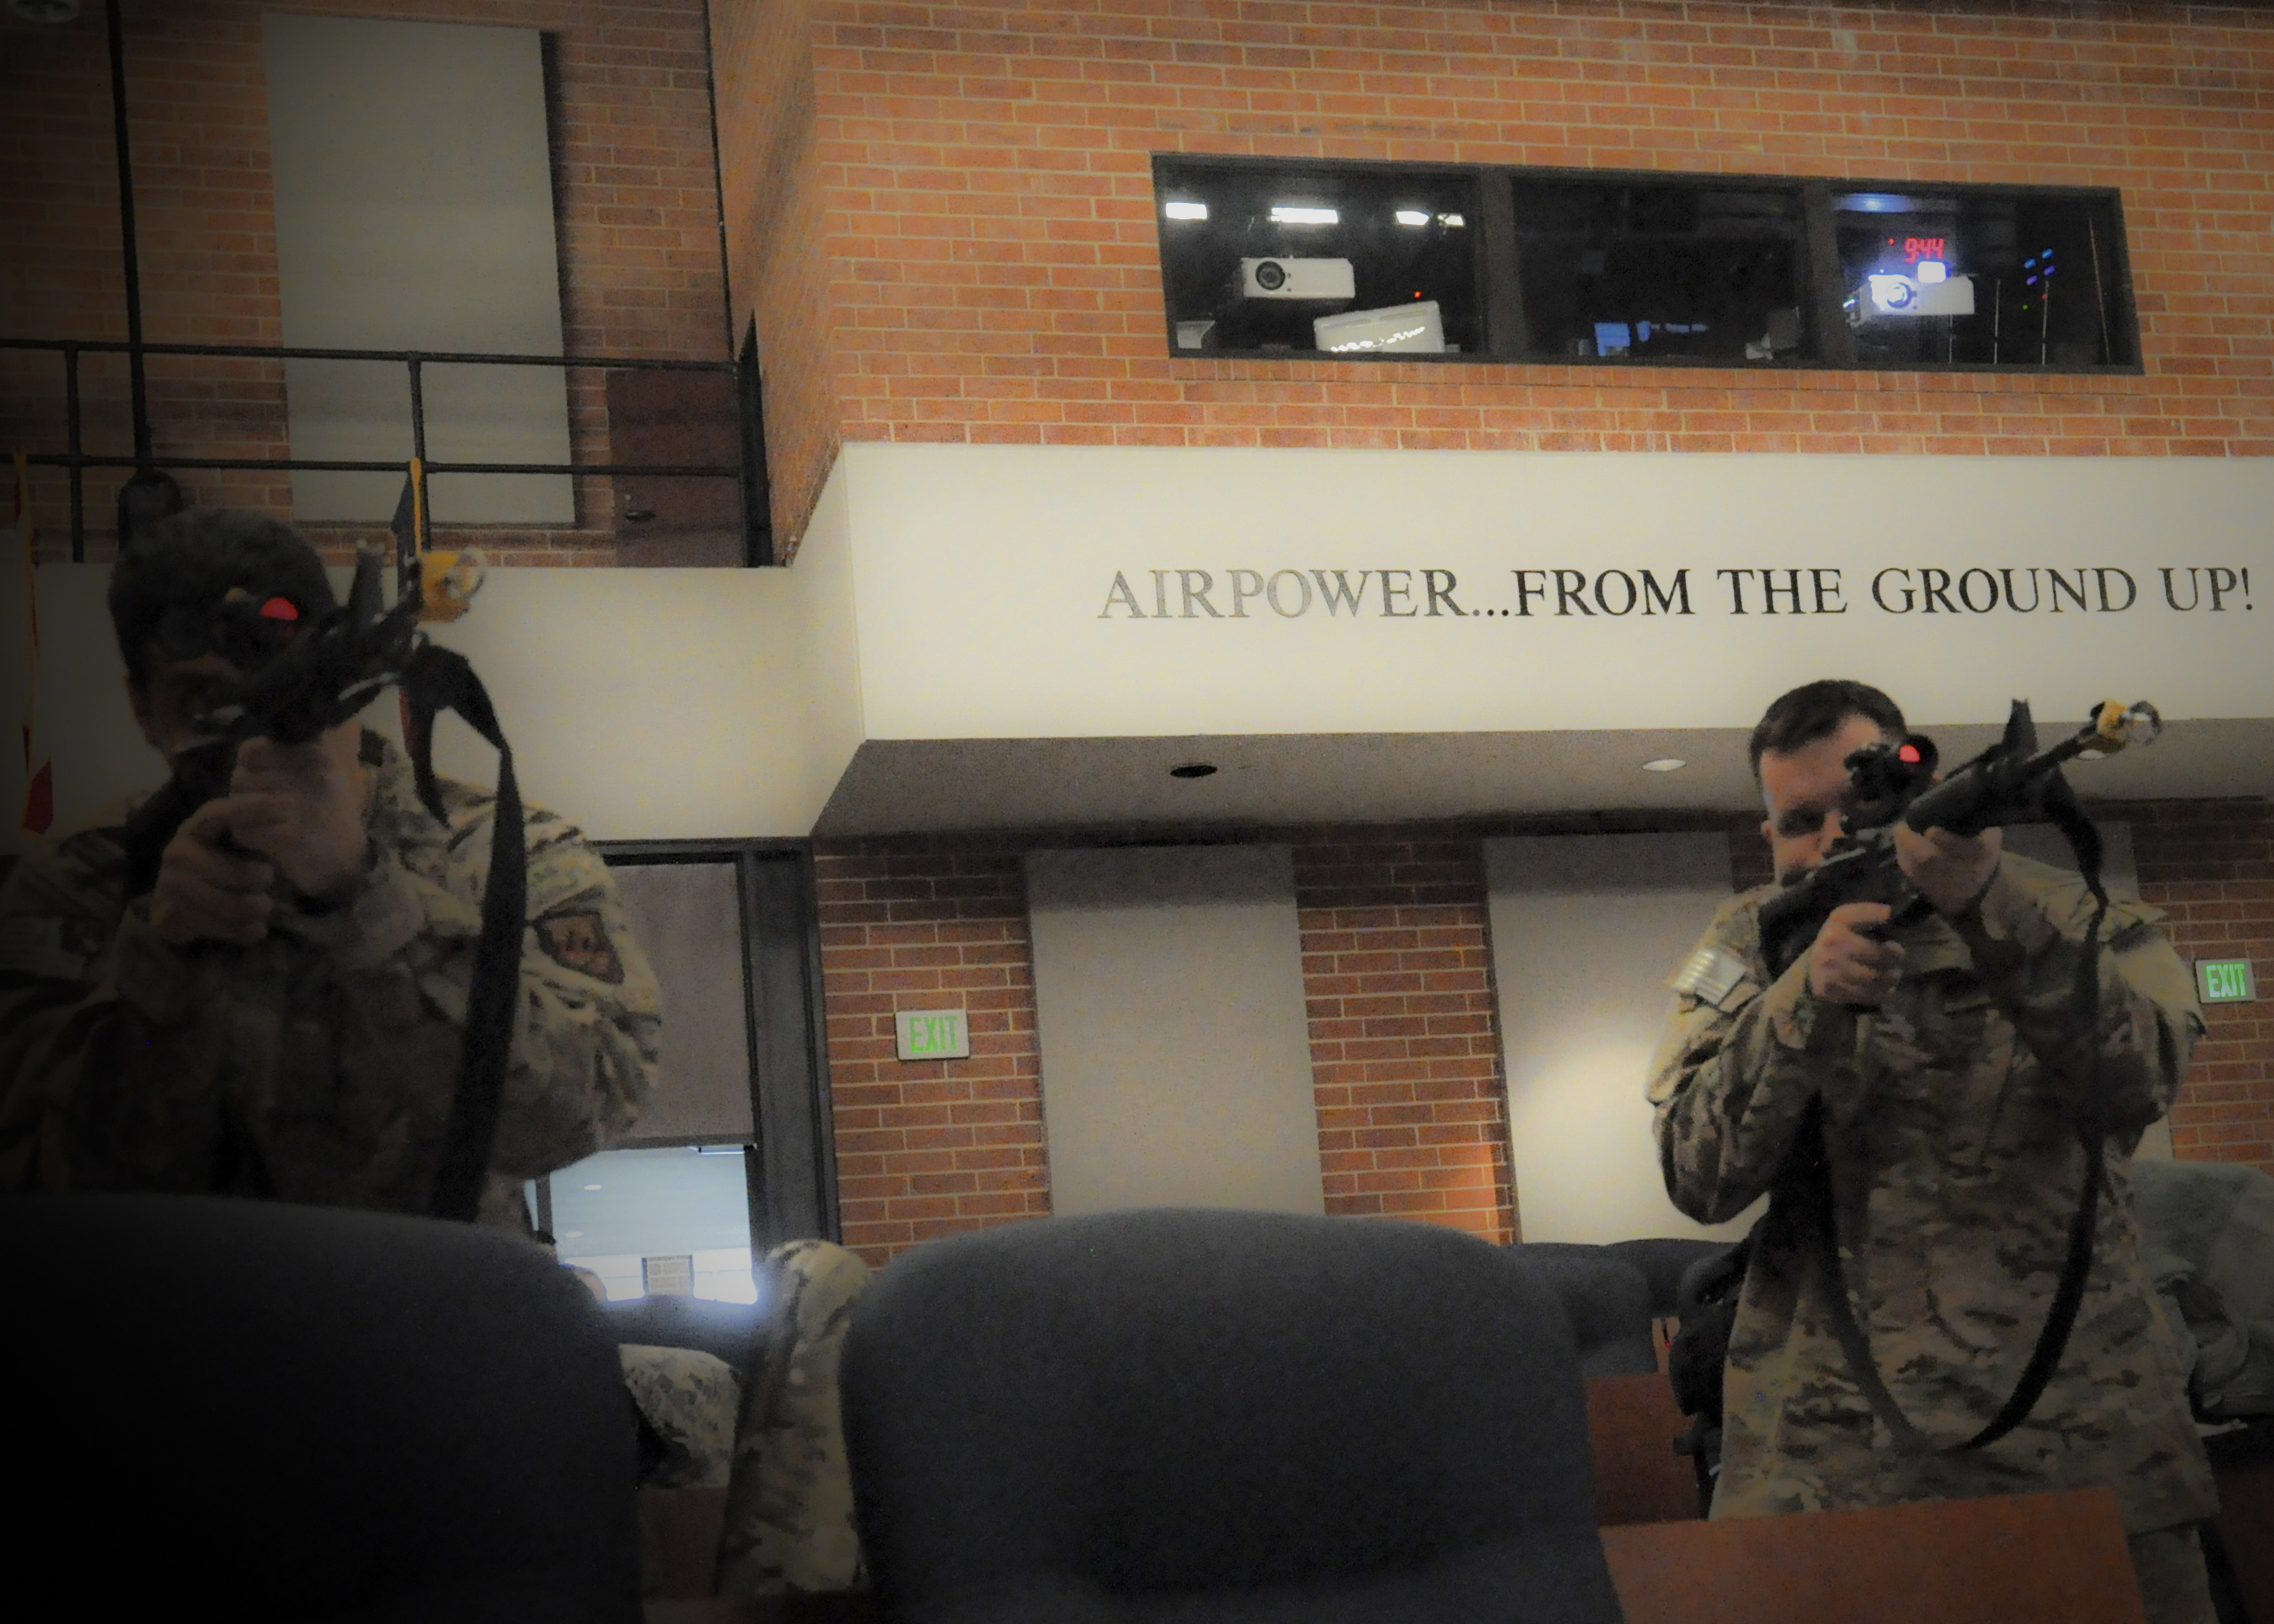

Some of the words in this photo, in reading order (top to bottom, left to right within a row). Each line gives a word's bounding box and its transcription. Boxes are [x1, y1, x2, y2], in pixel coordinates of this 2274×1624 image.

[1716, 568, 1848, 615] THE
[1871, 567, 2137, 614] GROUND
[2157, 566, 2253, 612] UP!
[2205, 962, 2246, 998] EXIT
[909, 1015, 958, 1053] EXIT
